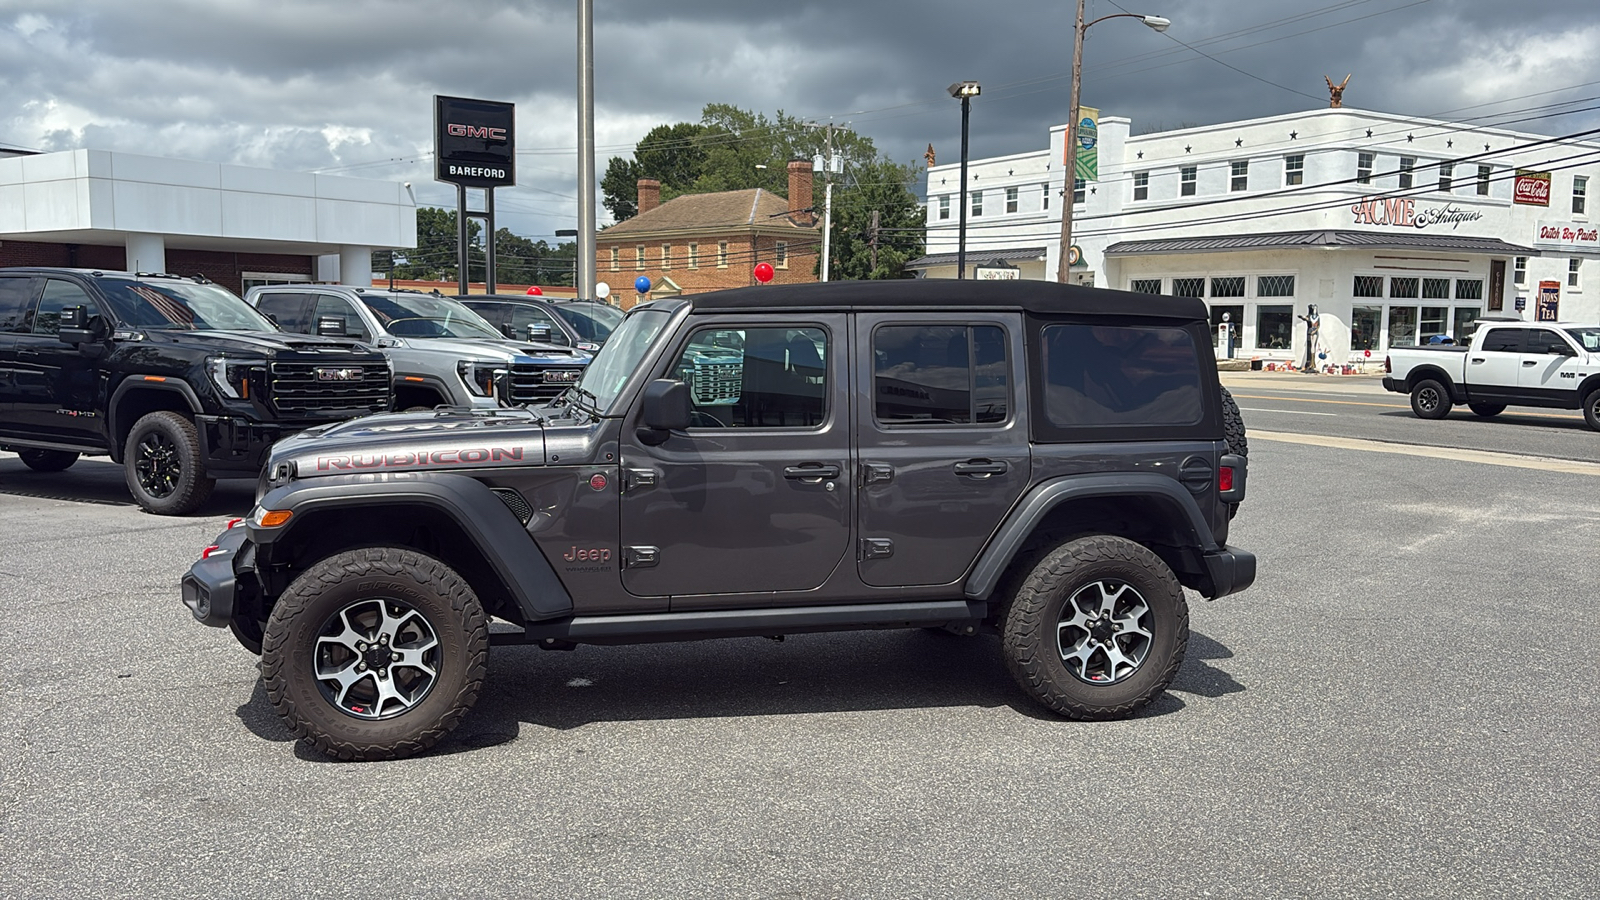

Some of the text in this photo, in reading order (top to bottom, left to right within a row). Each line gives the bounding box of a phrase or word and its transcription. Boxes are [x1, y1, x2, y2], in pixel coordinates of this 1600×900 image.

[448, 124, 506, 140] GMC
[449, 165, 505, 178] BAREFORD
[1351, 196, 1415, 227] ACME
[1540, 226, 1598, 243] Dutch Boy Paints
[1541, 308, 1555, 319] TEA
[318, 369, 363, 380] GMC
[317, 447, 523, 471] RUBICON
[564, 546, 612, 563] Jeep
